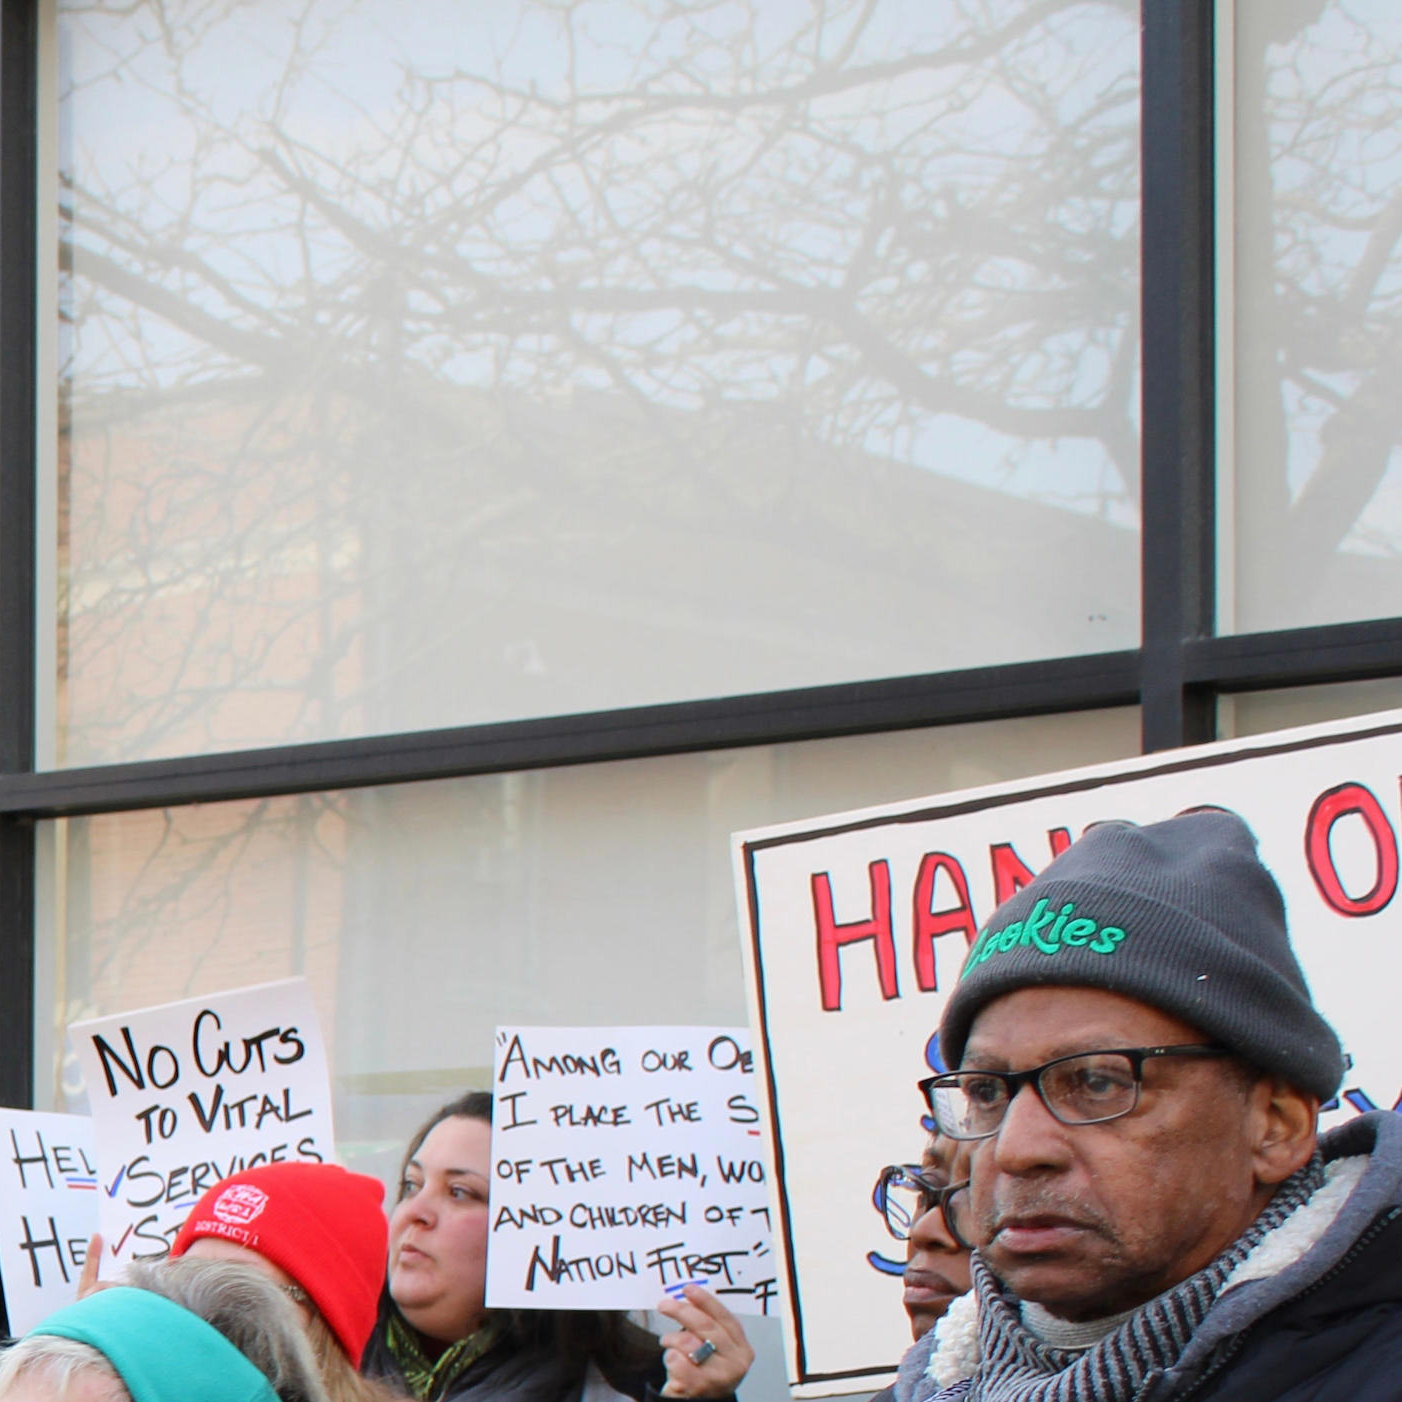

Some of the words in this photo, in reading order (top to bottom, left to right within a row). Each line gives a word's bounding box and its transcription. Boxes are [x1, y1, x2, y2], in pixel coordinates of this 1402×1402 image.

[92, 1026, 181, 1098] NO
[192, 1008, 306, 1079] CUTS
[640, 1048, 693, 1073] OUR
[135, 1103, 177, 1146] TO
[187, 1083, 313, 1134] VITAL
[499, 1091, 538, 1132] I
[550, 1103, 631, 1128] PLACE
[644, 1097, 703, 1128] THE
[496, 1158, 533, 1184] OF
[540, 1157, 607, 1186] THE
[627, 1152, 708, 1189] MEN,
[493, 1203, 563, 1233] AND
[569, 1201, 688, 1231] CHILDREN
[704, 1205, 743, 1229] OF
[525, 1234, 637, 1291] NATION
